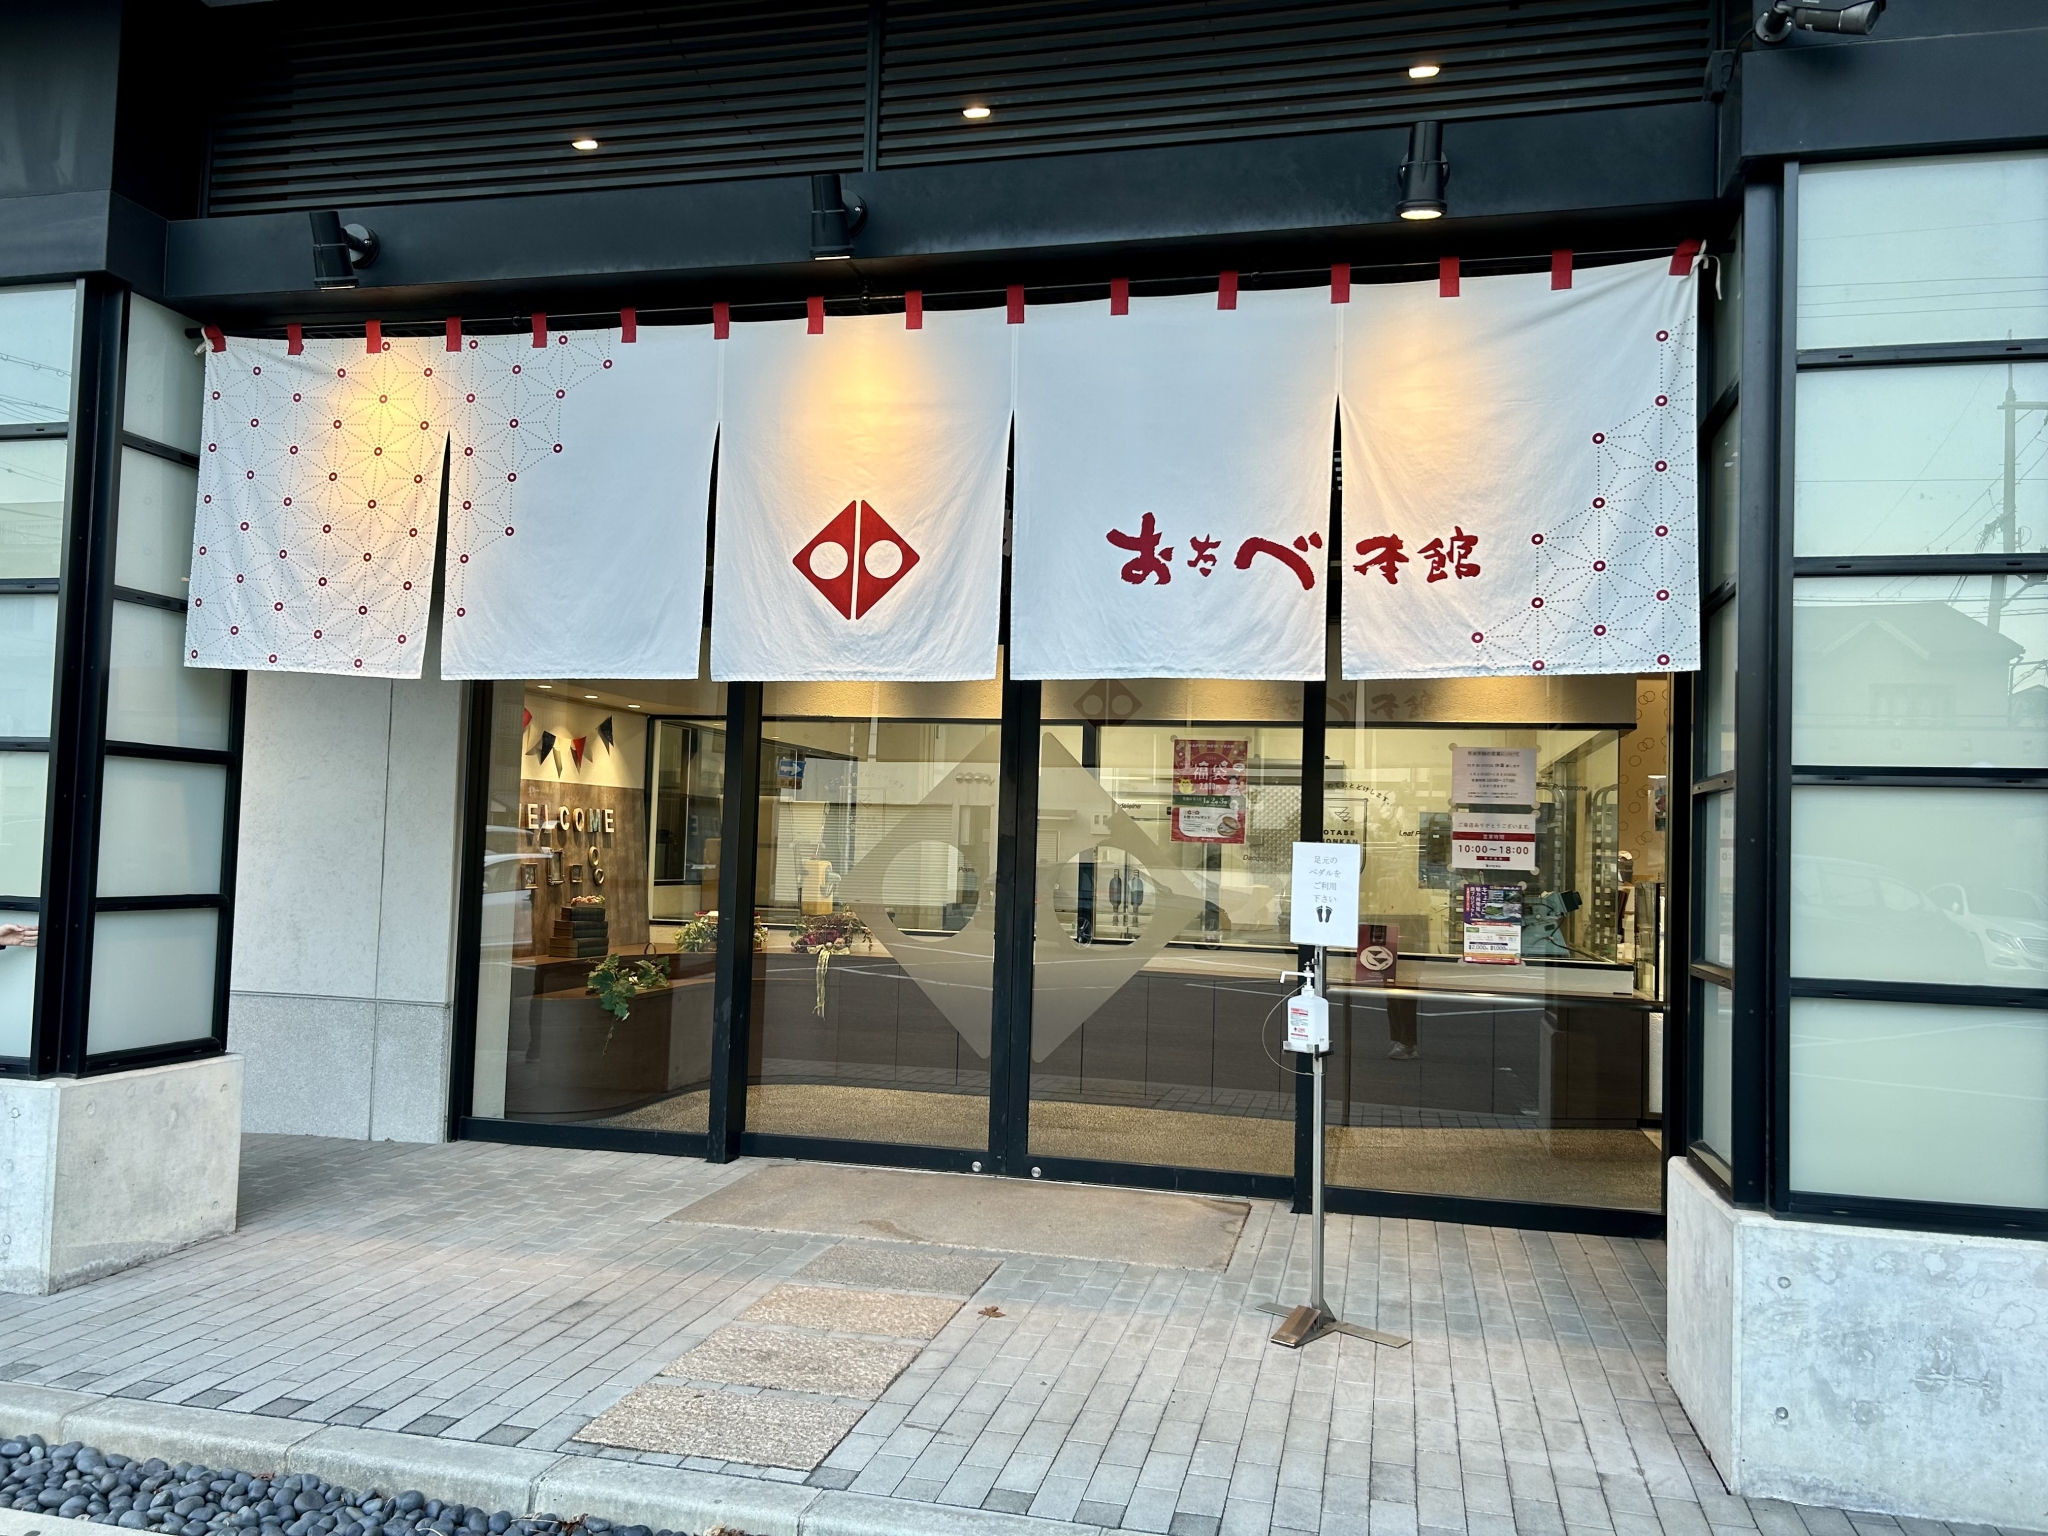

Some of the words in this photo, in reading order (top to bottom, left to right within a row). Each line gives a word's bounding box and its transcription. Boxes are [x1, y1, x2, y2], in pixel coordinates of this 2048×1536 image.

[518, 802, 615, 833] ELCOME
[1323, 829, 1355, 837] OTABE
[1313, 855, 1338, 865] 足元の
[1308, 868, 1342, 878] ペダルを
[1313, 881, 1337, 891] ご利用
[1313, 894, 1337, 904] 下さい
